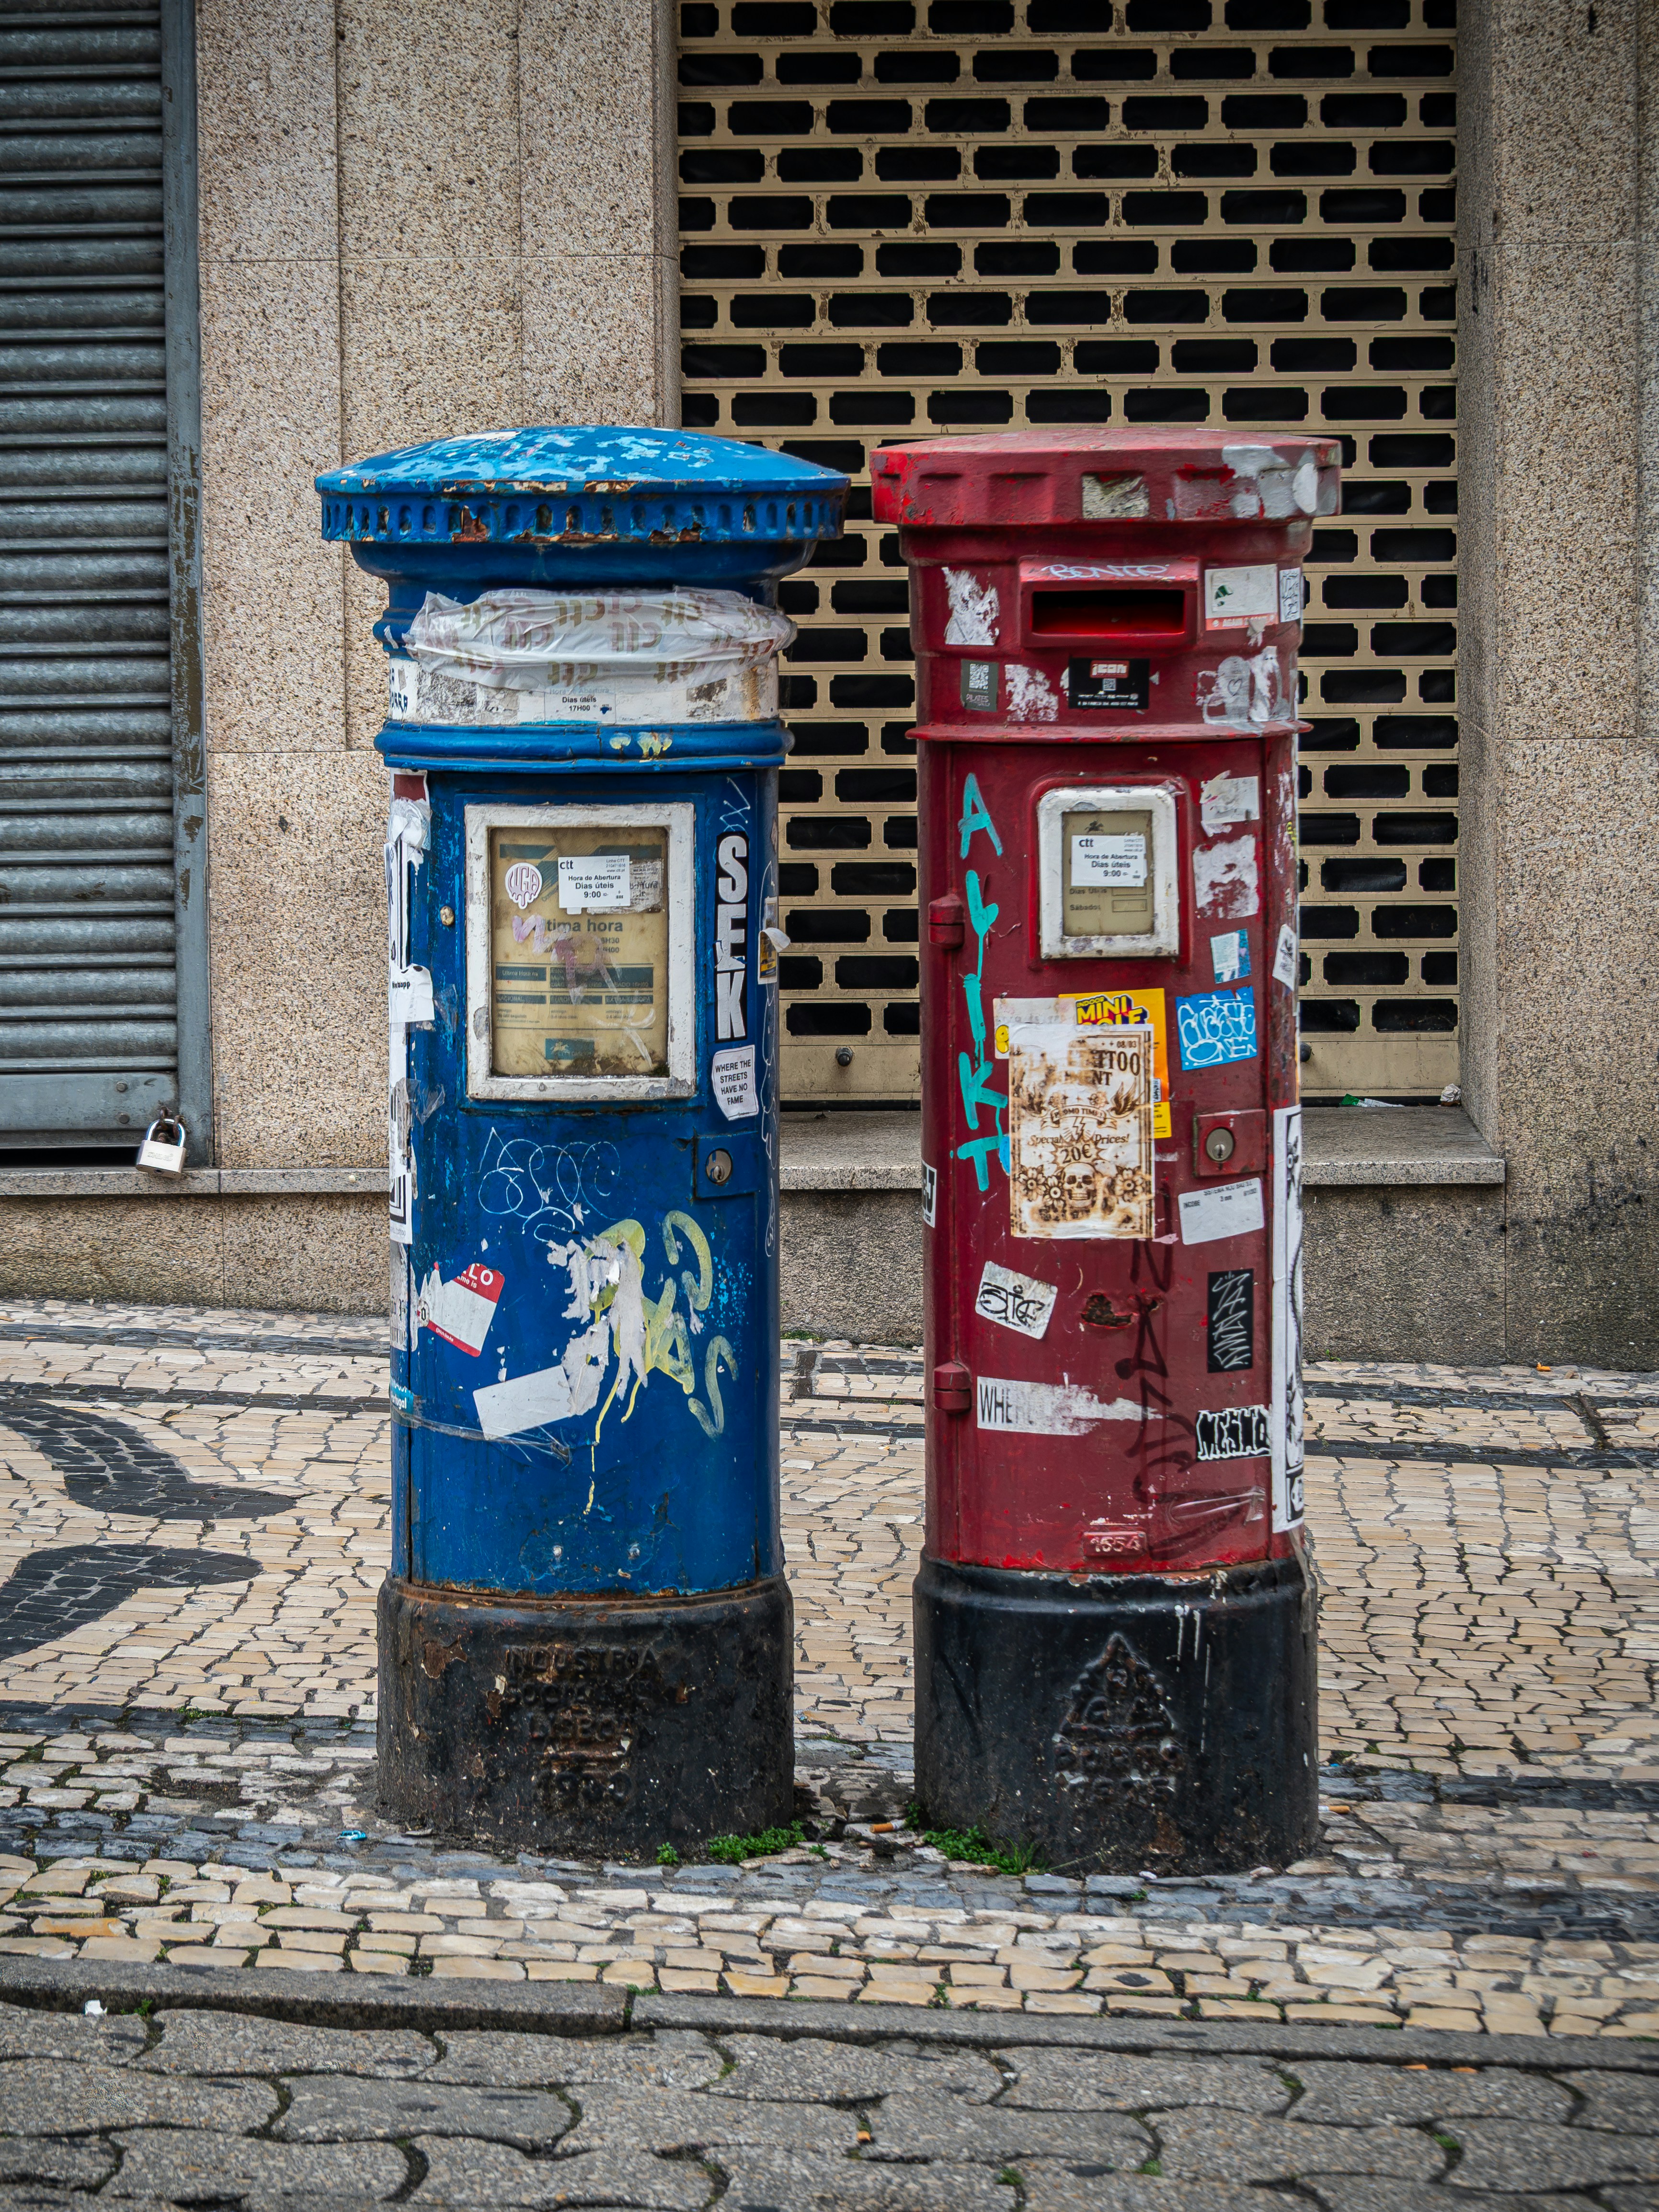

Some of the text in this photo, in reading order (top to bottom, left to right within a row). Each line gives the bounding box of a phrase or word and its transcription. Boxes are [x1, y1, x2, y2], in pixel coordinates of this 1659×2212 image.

[1079, 838, 1094, 847] ctt
[560, 860, 574, 870] ctt
[587, 918, 623, 932] hora
[1077, 996, 1128, 1024] MINI
[715, 1059, 751, 1073] WHERE THE
[720, 1071, 748, 1084] STREETS
[721, 1082, 748, 1095] HAVE NO
[727, 1095, 744, 1105] FAME
[1028, 1134, 1130, 1146] Special Prices!
[1060, 1144, 1093, 1164] 20€
